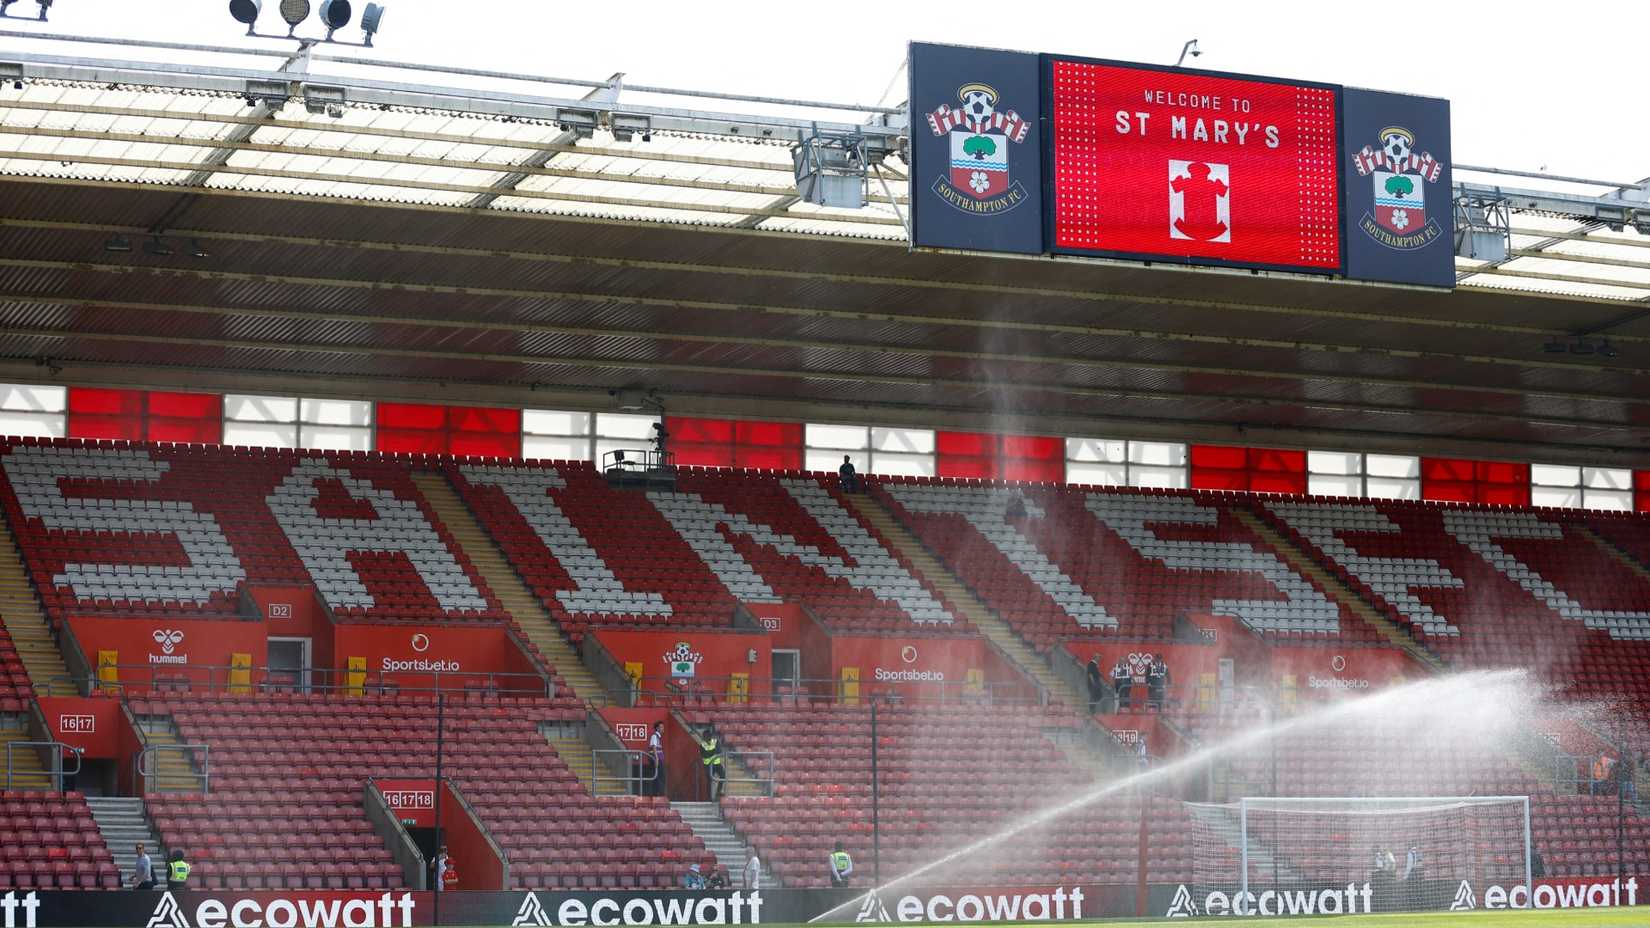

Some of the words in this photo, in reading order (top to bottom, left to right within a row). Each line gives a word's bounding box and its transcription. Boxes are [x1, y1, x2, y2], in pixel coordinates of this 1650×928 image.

[1144, 89, 1221, 111] WELCOME
[1231, 98, 1250, 113] TO
[1115, 110, 1150, 136] ST
[1171, 115, 1280, 148] MARY'S
[937, 183, 1009, 212] SOUTHAMPTON
[1008, 189, 1022, 204] FC
[1364, 220, 1425, 247] SOUTHAMPTON
[1424, 226, 1437, 240] FC
[1, 445, 1341, 635] SAINTS
[272, 606, 288, 616] D2
[149, 653, 187, 664] hummel
[382, 657, 460, 671] Sportsbet.io
[875, 667, 944, 681] Sportsbet.io
[63, 718, 76, 729] 16
[80, 718, 92, 729] 17
[619, 727, 631, 737] 17
[633, 727, 645, 738] 18
[385, 794, 399, 805] 16
[402, 794, 415, 805] 17
[418, 794, 431, 805] 18
[896, 886, 1085, 922] ecowatt
[1205, 881, 1374, 916] ecowatt
[1484, 876, 1638, 909] ecowatt
[196, 891, 416, 928] ecowatt
[558, 890, 763, 927] ecowatt
